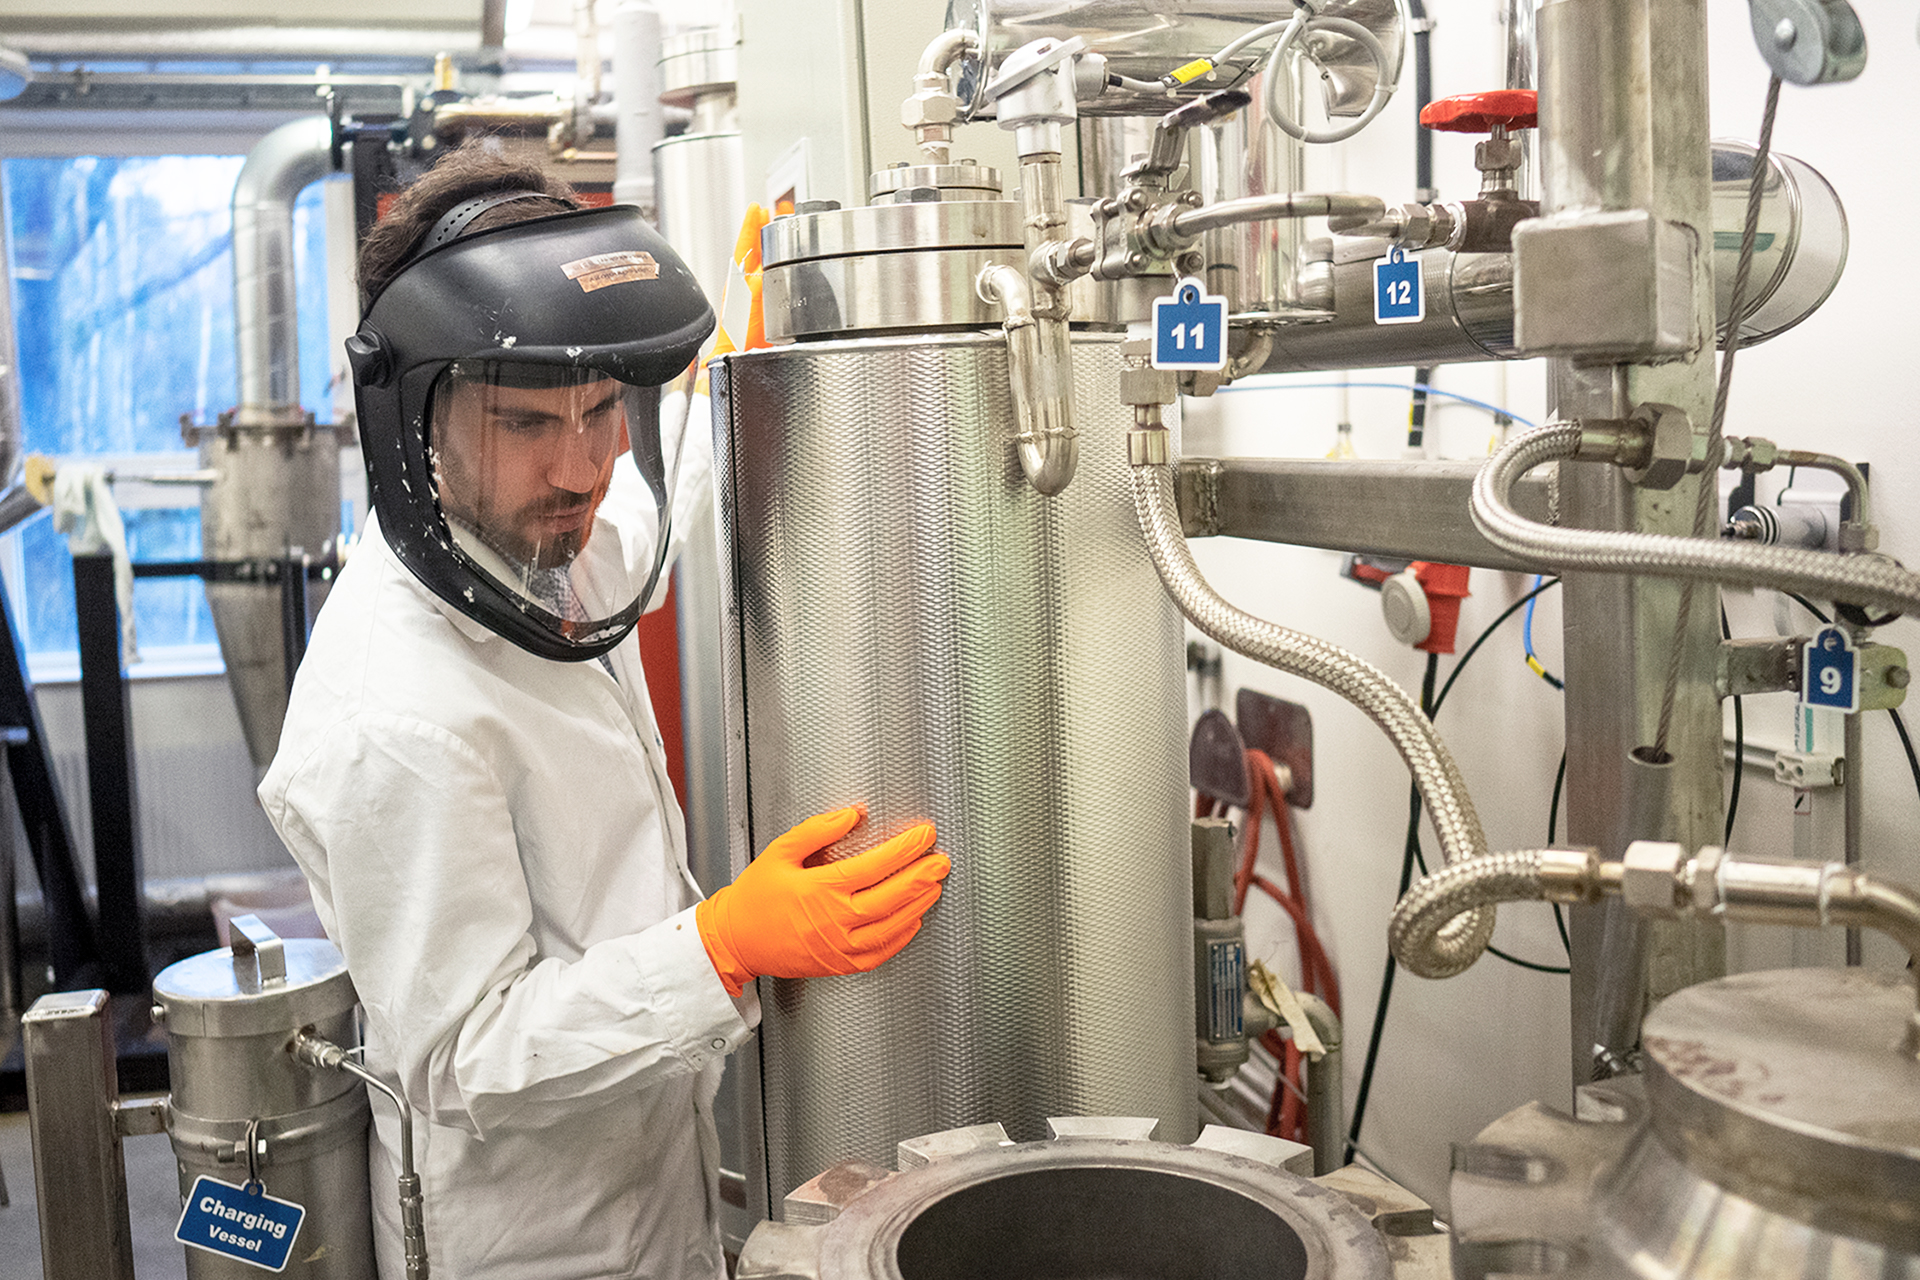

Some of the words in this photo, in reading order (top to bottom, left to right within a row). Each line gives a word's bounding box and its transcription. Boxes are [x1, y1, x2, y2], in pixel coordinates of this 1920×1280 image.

[1386, 280, 1412, 305] 12
[1170, 322, 1205, 350] 11
[1820, 666, 1842, 695] 9
[199, 1196, 288, 1239] Charging
[209, 1224, 263, 1253] Vessel
